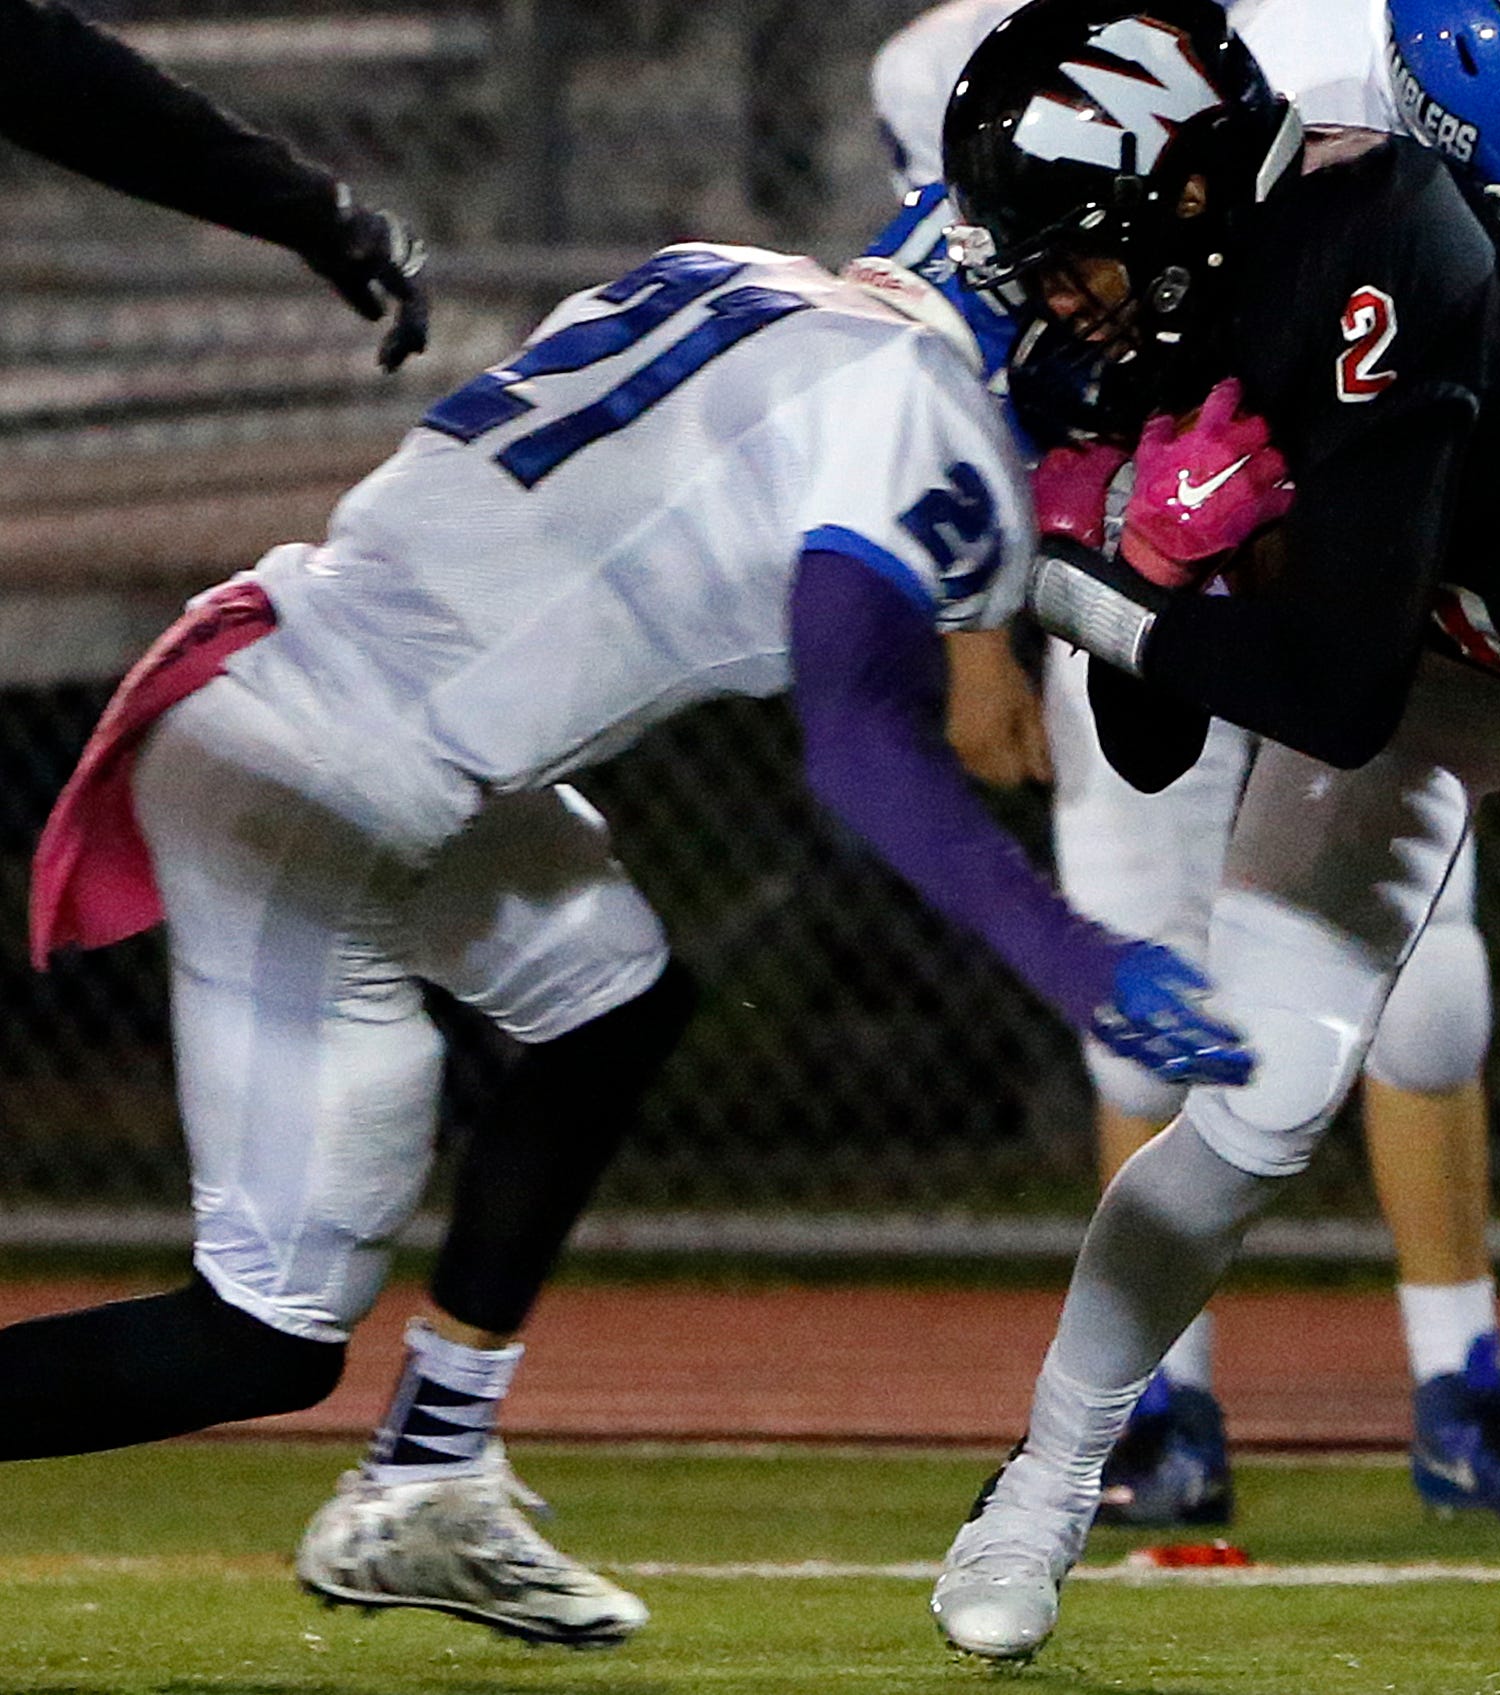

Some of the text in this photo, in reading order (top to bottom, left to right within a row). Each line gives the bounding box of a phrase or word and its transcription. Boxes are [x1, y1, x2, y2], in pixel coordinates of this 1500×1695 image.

[1012, 16, 1224, 176] W
[420, 249, 816, 489] 21
[1336, 285, 1398, 402] 2
